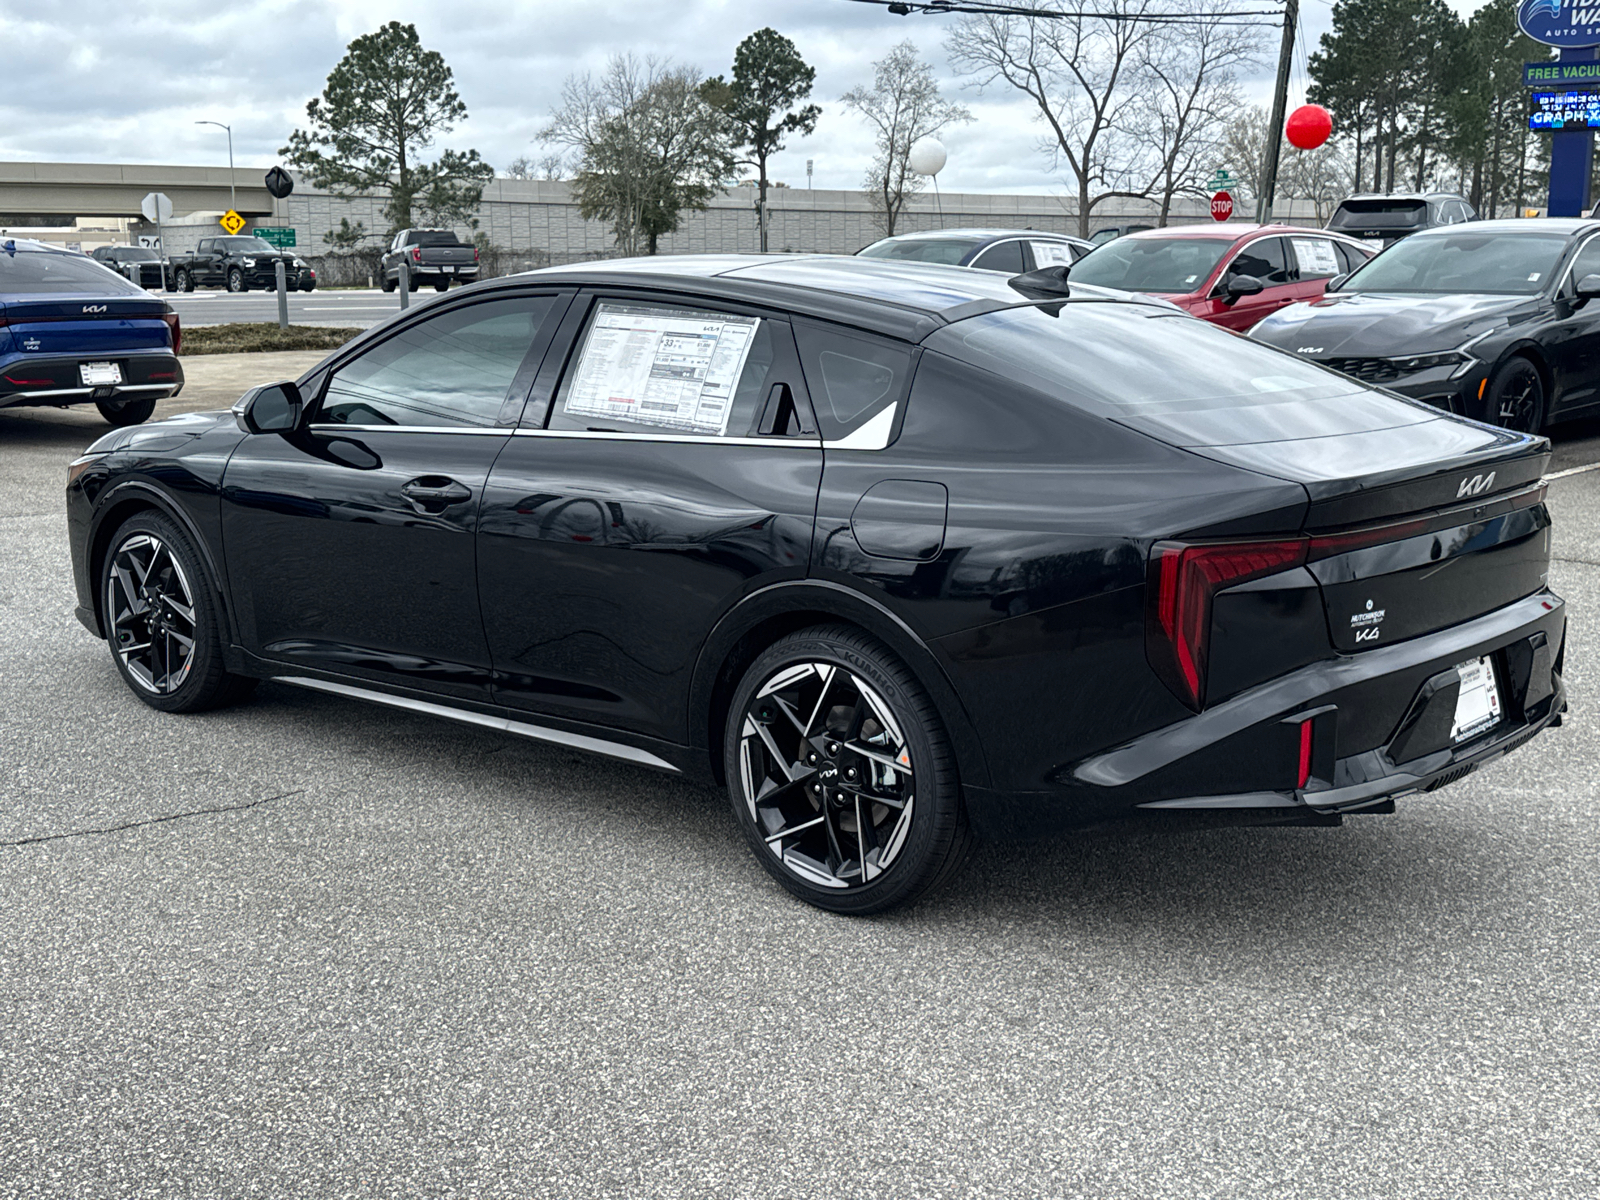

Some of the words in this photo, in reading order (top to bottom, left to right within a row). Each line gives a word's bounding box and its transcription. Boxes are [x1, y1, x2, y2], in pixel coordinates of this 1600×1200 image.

[1545, 29, 1577, 37] AUTO
[1528, 67, 1560, 80] FREE
[1211, 200, 1232, 213] STOP
[82, 305, 107, 313] KIA
[663, 339, 674, 347] 33
[1456, 471, 1496, 498] KIA
[1355, 627, 1380, 643] K4
[844, 651, 896, 698] KUMHO
